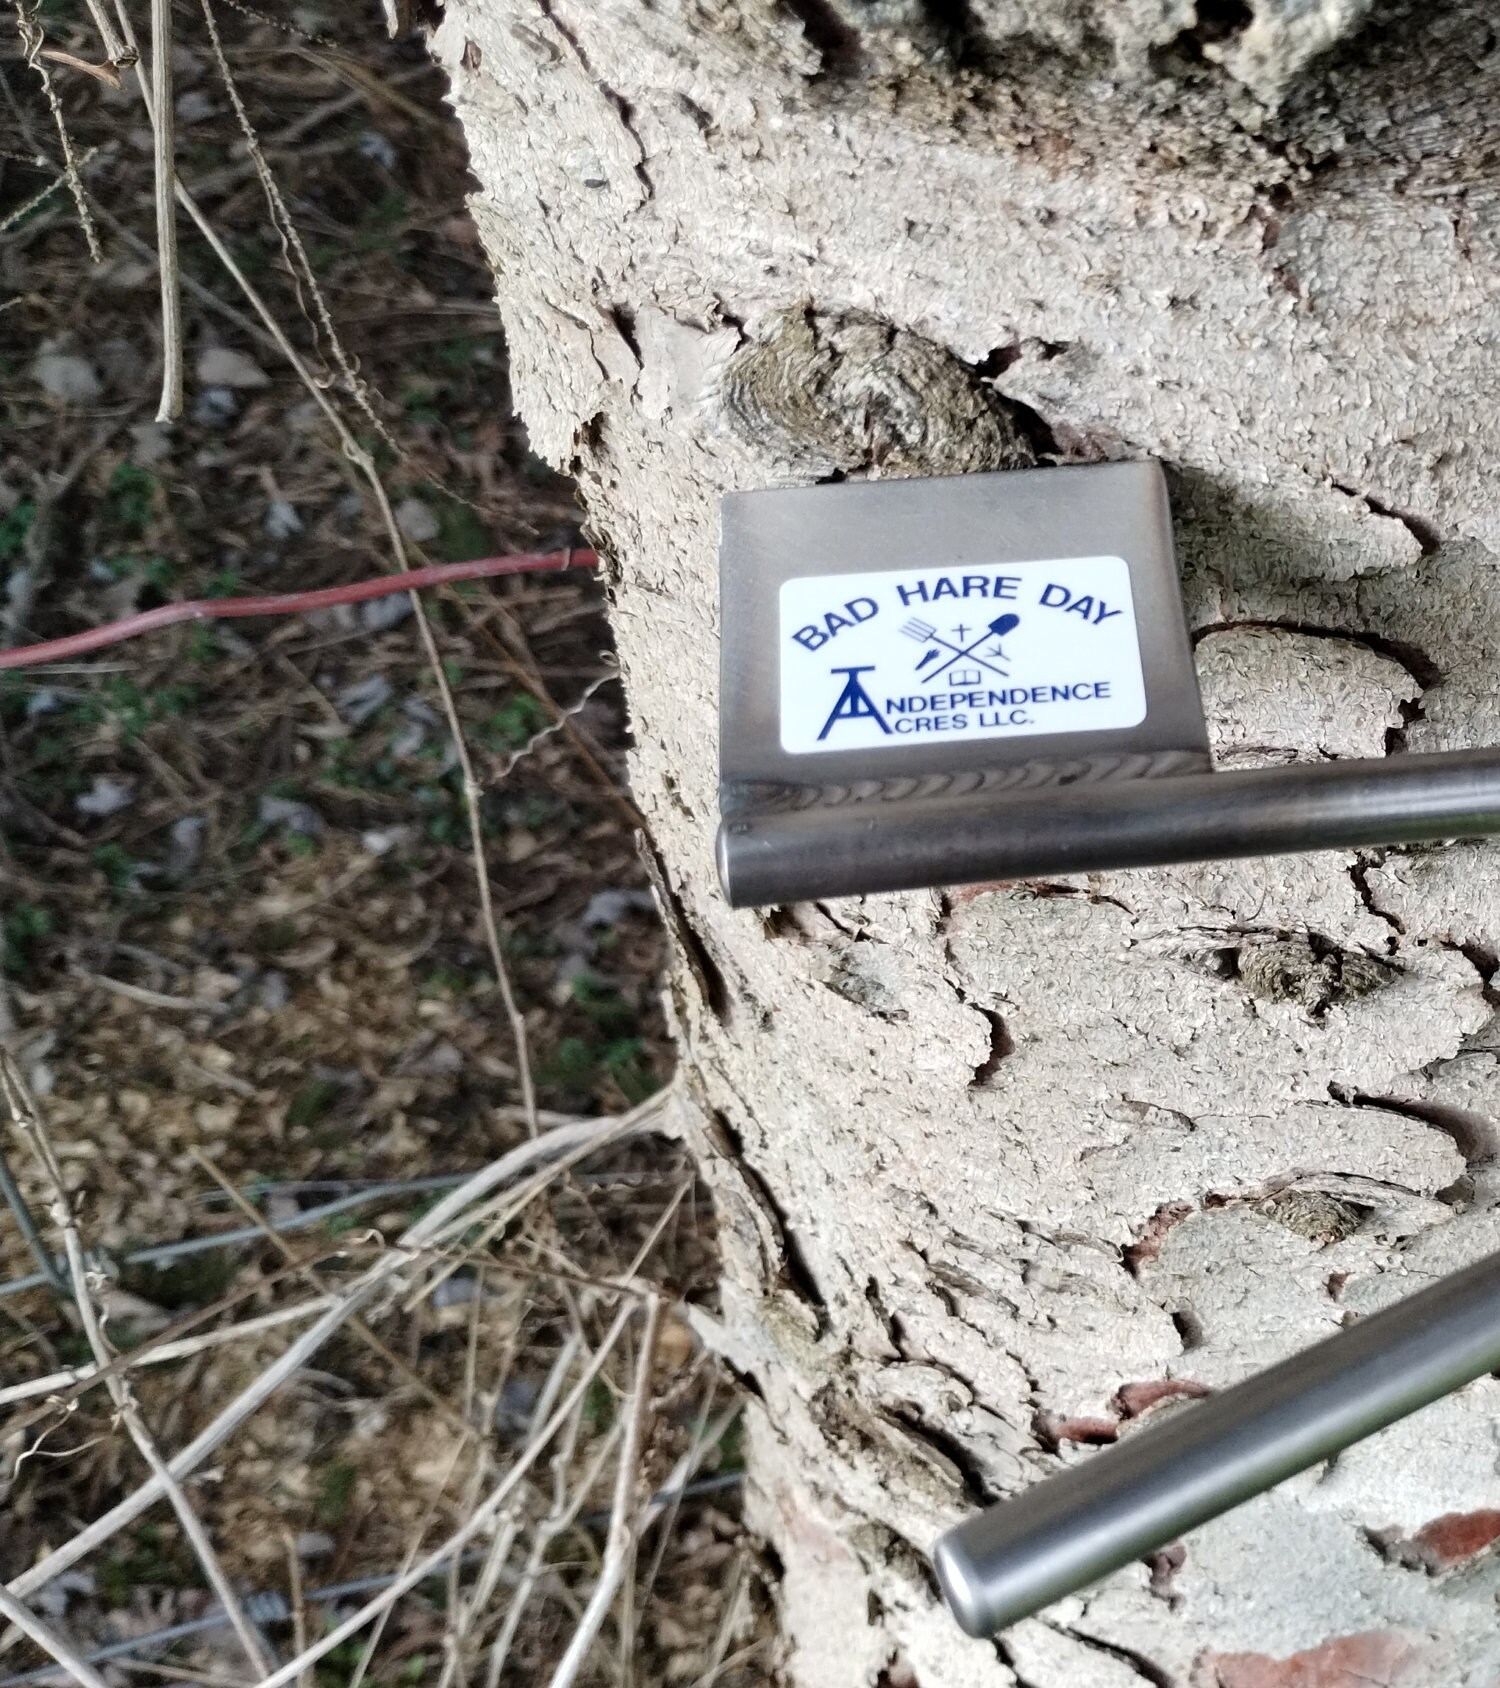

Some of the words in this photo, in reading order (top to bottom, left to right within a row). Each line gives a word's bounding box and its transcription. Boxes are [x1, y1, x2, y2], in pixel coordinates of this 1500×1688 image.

[792, 597, 880, 651] BAD
[896, 575, 1022, 606] HARE
[1039, 583, 1122, 625] DAY
